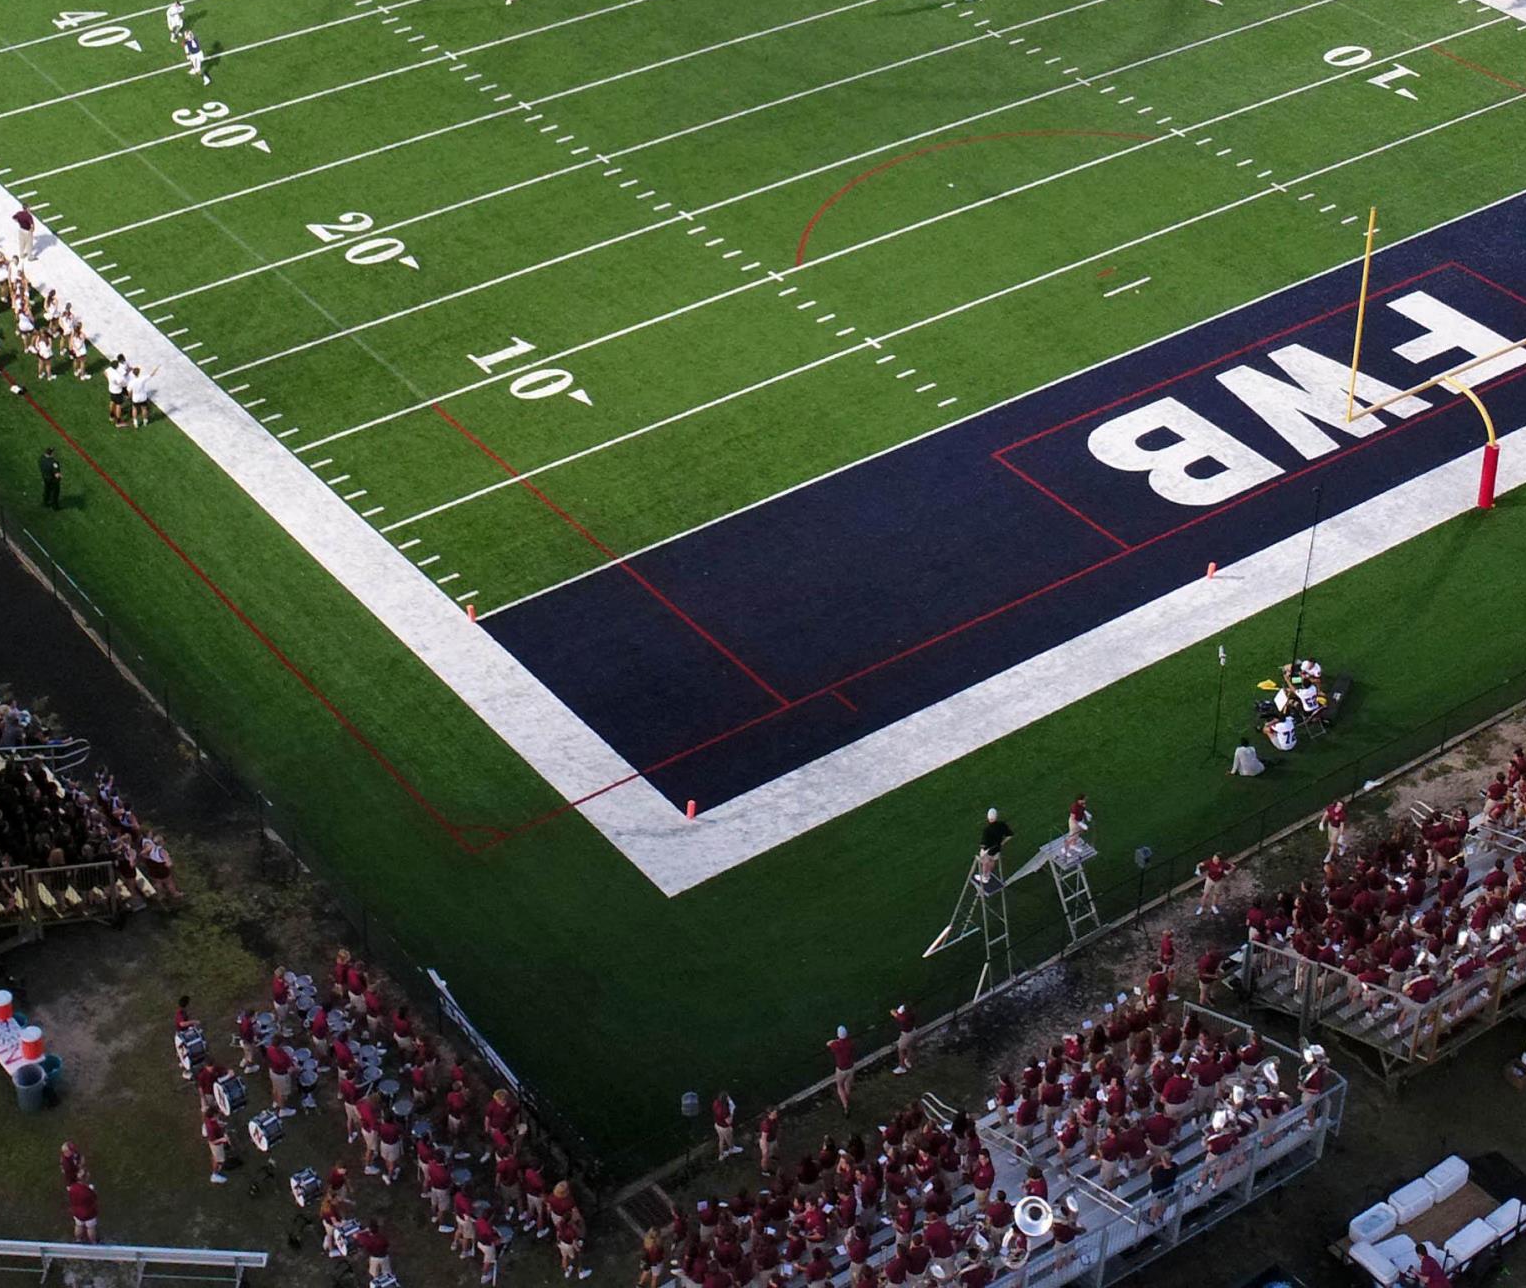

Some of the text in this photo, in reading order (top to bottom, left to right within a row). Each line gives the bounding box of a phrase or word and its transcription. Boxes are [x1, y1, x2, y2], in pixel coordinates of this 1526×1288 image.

[52, 10, 132, 48] 40
[1323, 45, 1420, 90] 10
[172, 101, 258, 148] 30
[306, 212, 405, 265] 20
[467, 336, 574, 400] 10
